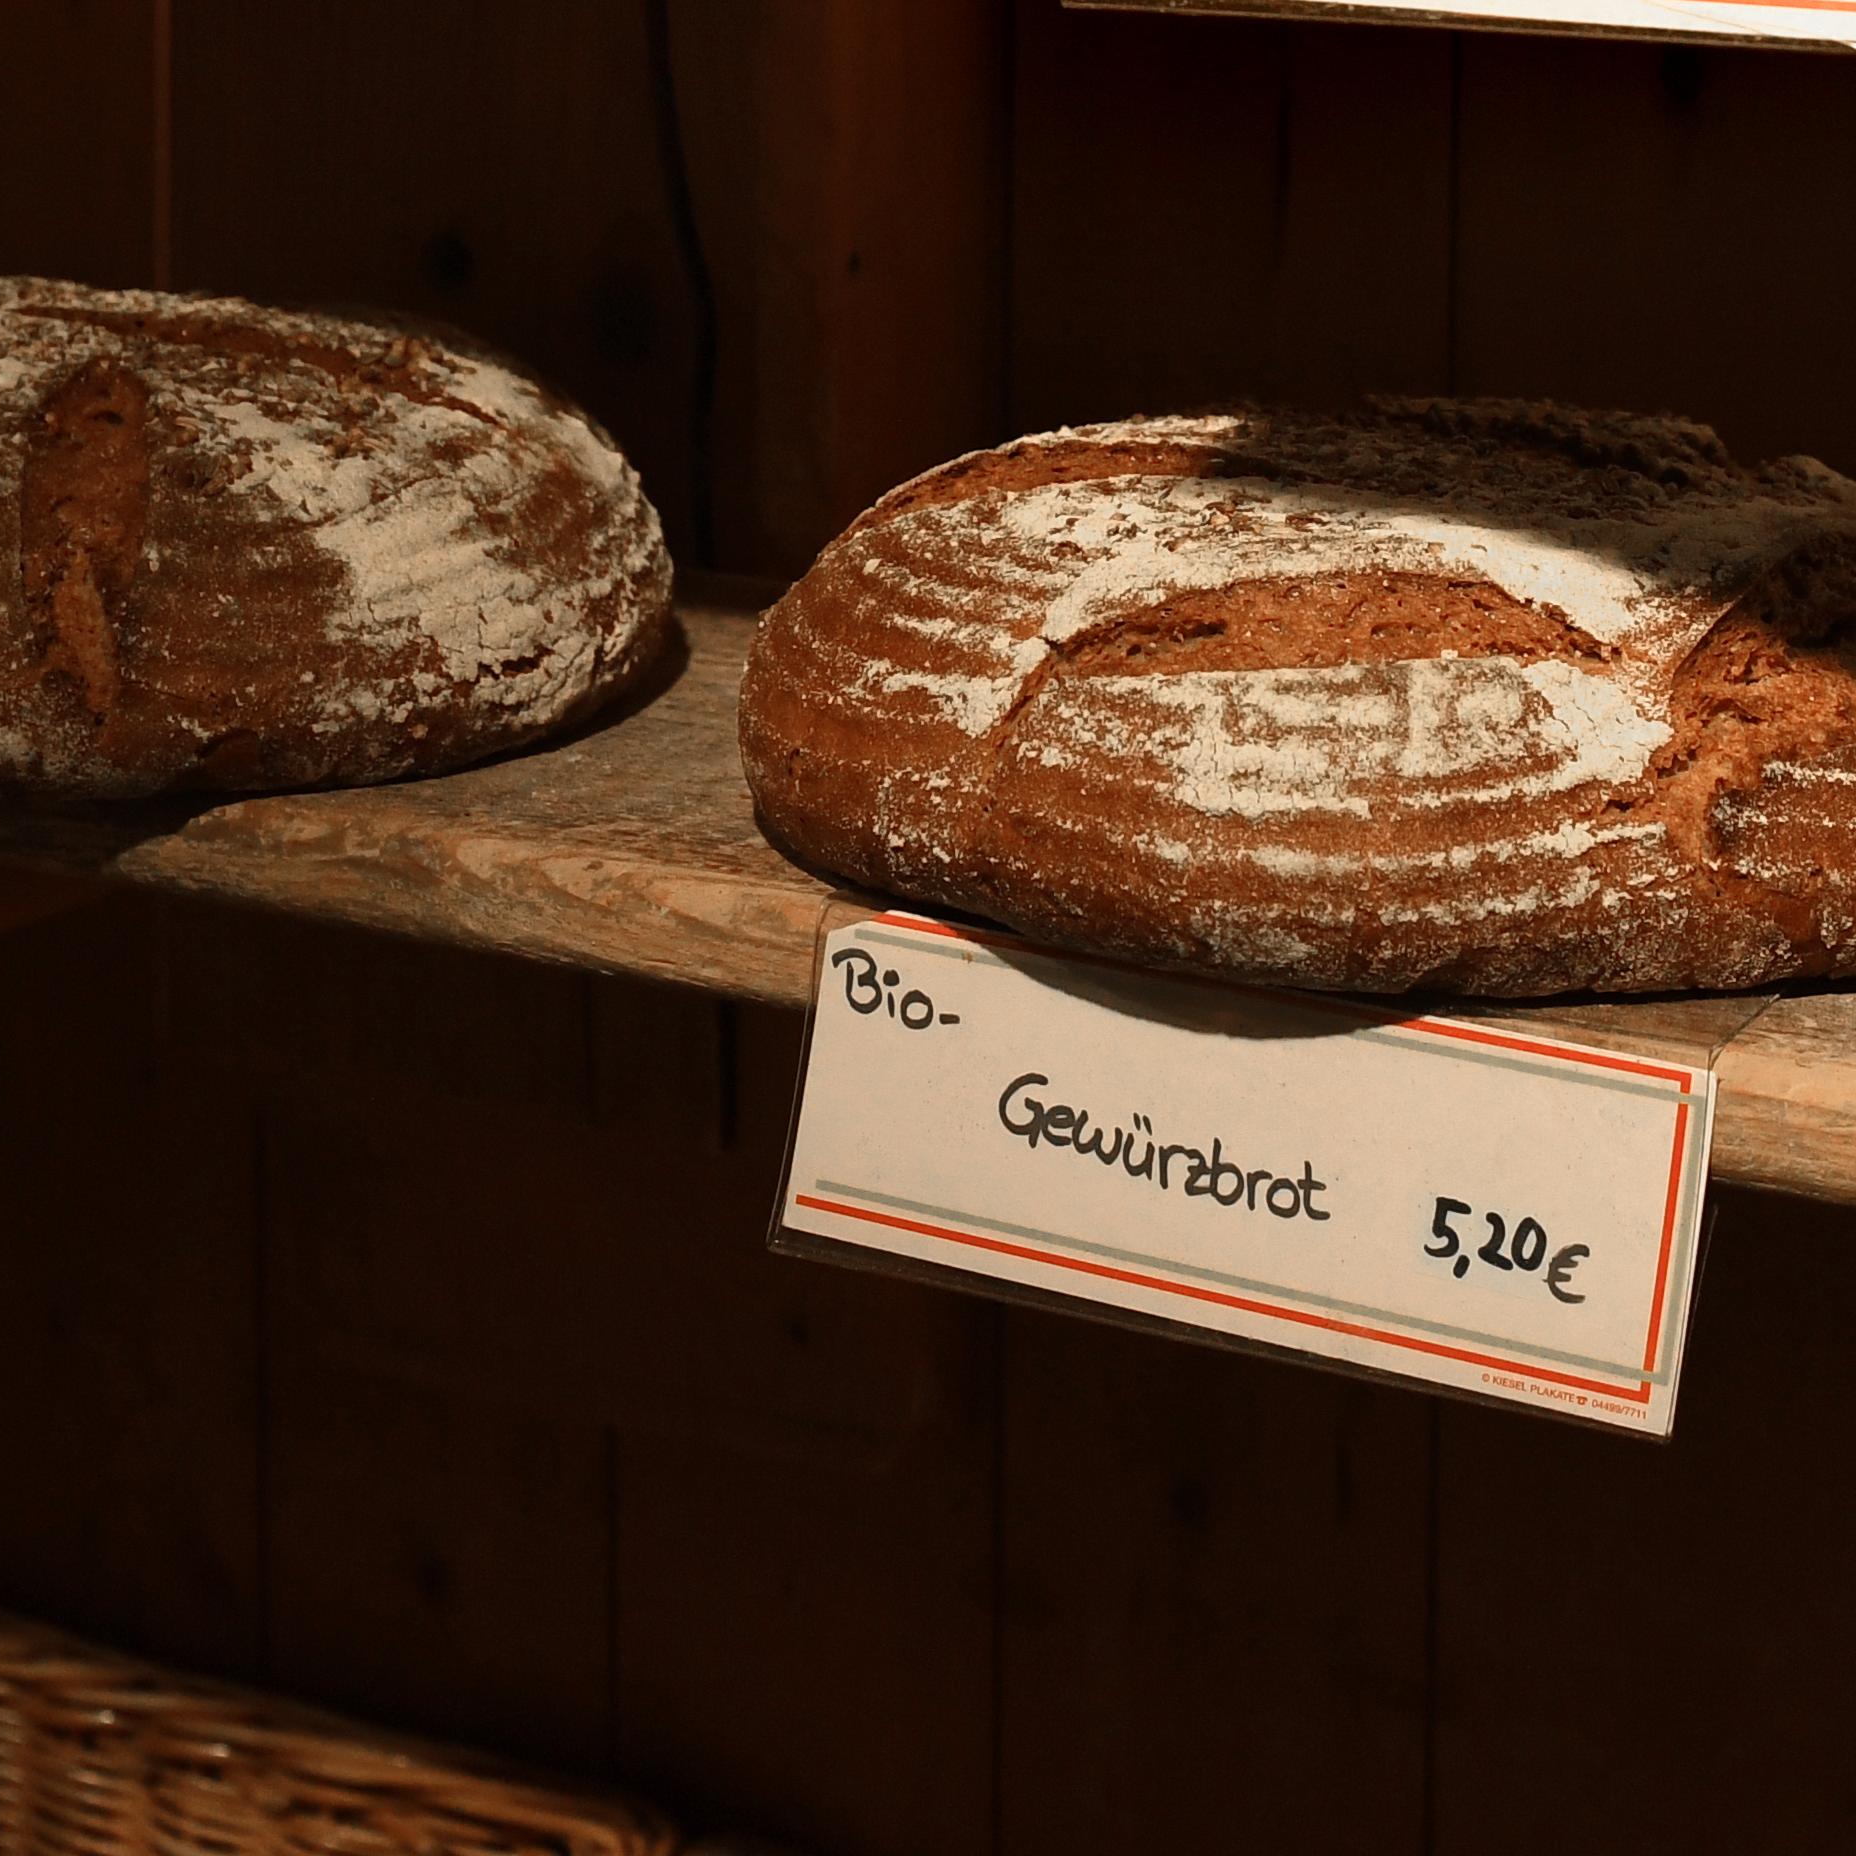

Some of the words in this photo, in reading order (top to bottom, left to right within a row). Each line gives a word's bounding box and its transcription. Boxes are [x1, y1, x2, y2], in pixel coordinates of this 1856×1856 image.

[831, 948, 961, 1030] Bio-
[998, 1072, 1331, 1221] Gewürzbrot
[1423, 1196, 1590, 1304] 5,20€
[1493, 1375, 1527, 1392] KIESEL
[1530, 1384, 1575, 1403] PLAKATE
